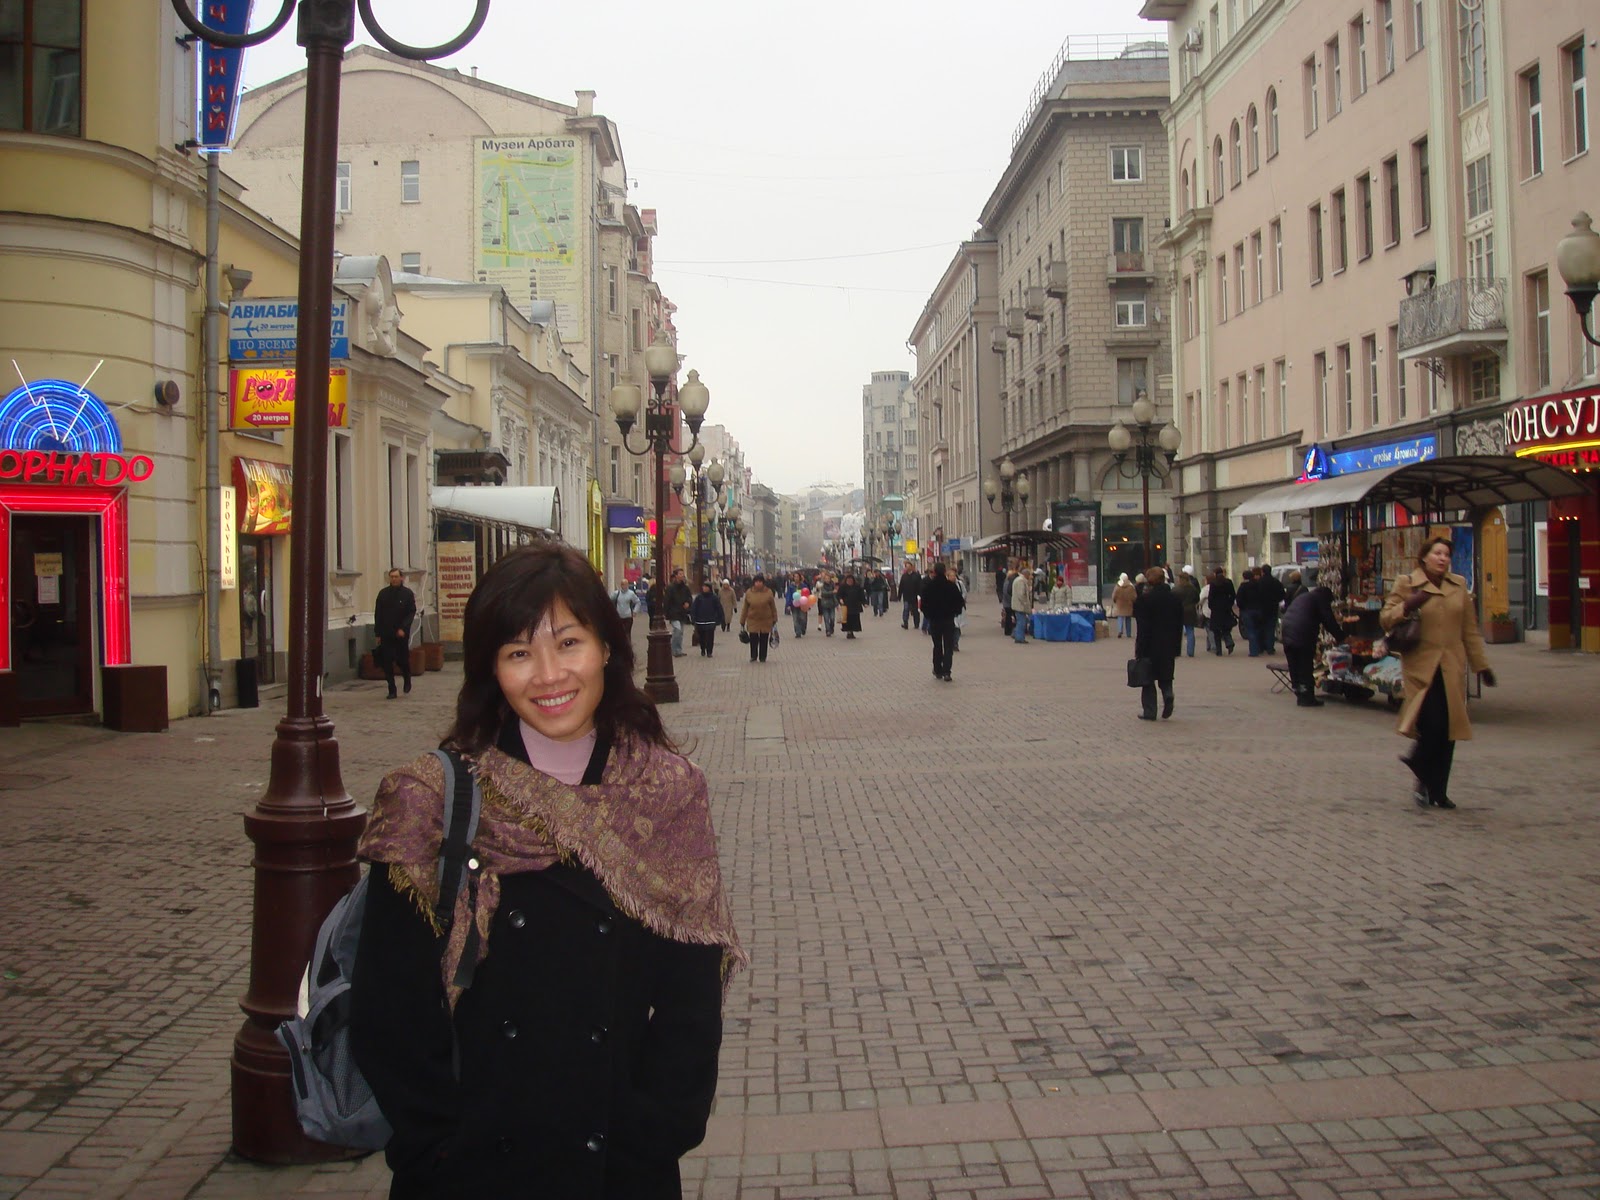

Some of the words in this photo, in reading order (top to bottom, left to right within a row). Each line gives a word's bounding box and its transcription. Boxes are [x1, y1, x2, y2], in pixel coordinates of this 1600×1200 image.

[482, 140, 524, 152] Музеи
[528, 138, 575, 151] Арбата
[270, 323, 295, 331] метров
[237, 340, 254, 350] ПО
[224, 490, 232, 575] ПРОДУКТЫ
